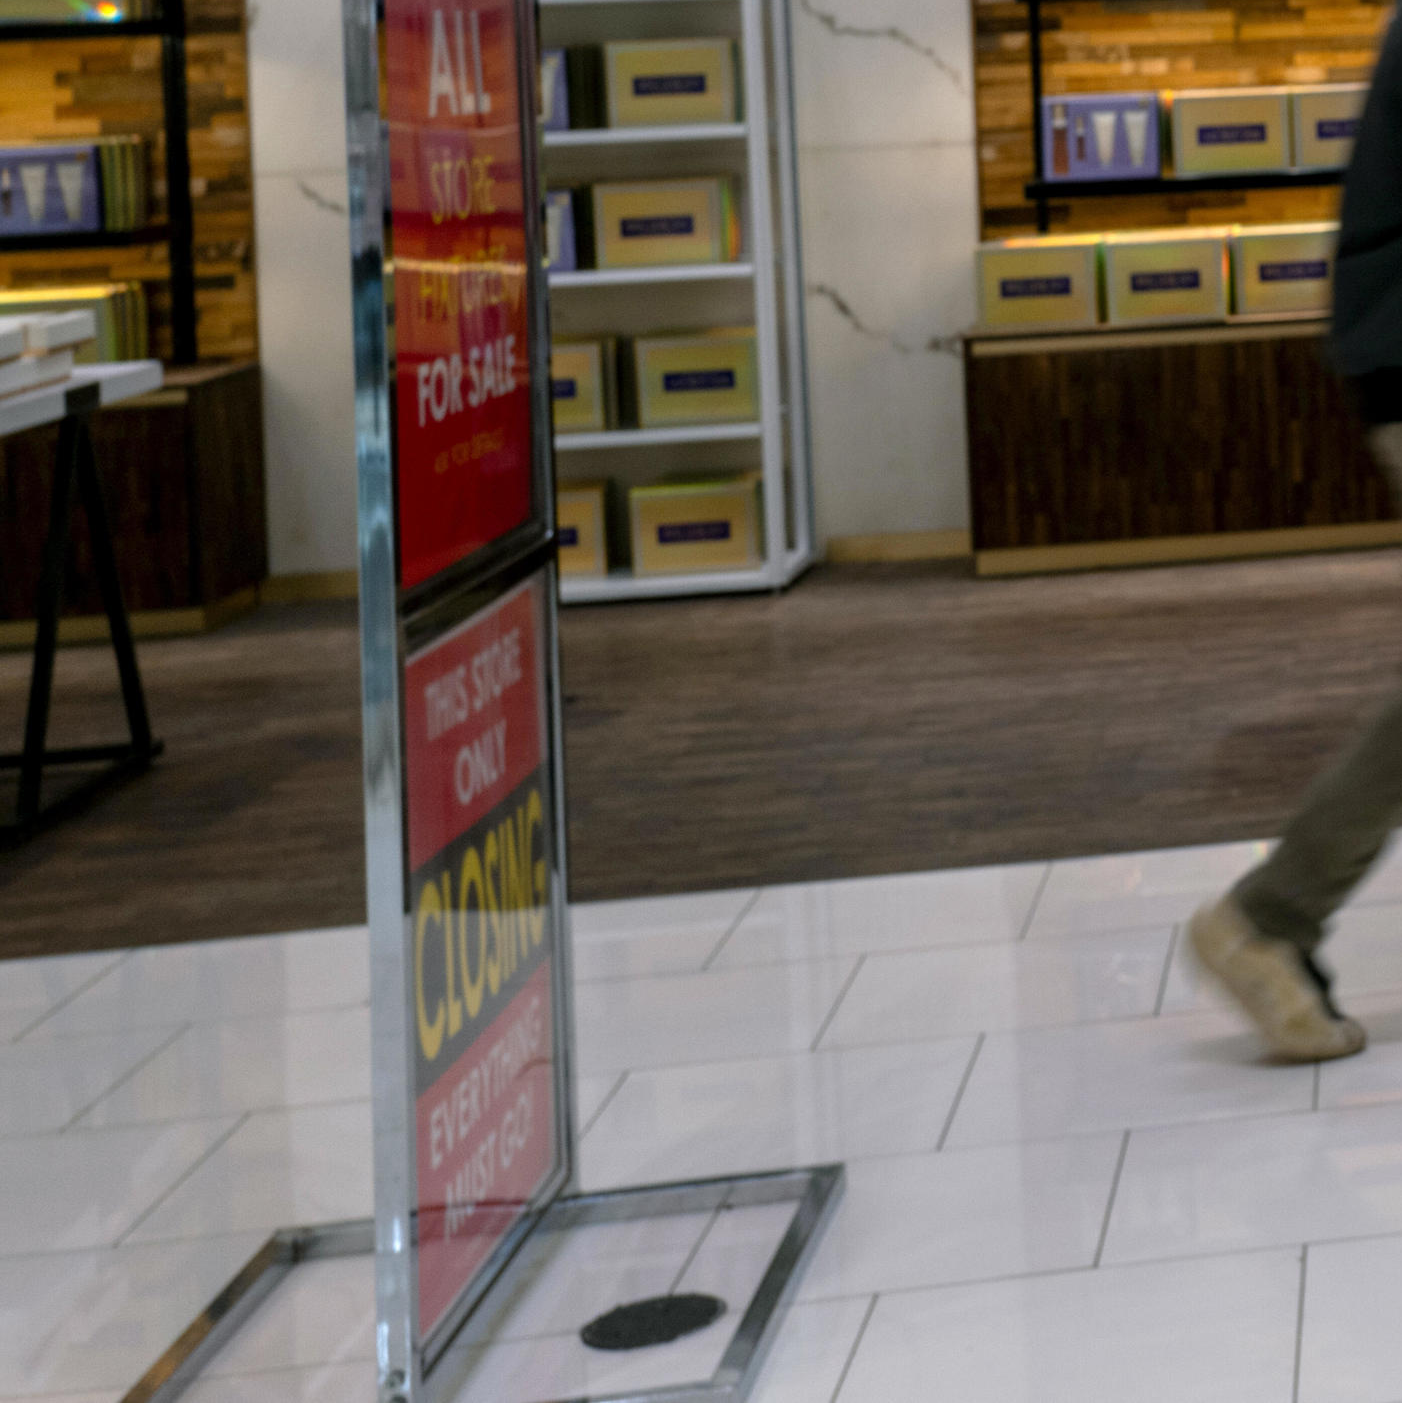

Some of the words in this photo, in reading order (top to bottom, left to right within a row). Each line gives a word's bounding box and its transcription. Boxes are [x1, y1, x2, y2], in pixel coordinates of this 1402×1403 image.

[428, 9, 491, 119] ALL
[430, 154, 497, 224] STORE
[417, 353, 464, 428] FOR
[468, 334, 516, 408] SALE
[472, 627, 523, 716] STORE
[453, 719, 508, 805] ONLY
[414, 789, 547, 1060] CLOSING
[428, 996, 543, 1171] EVERYTHING
